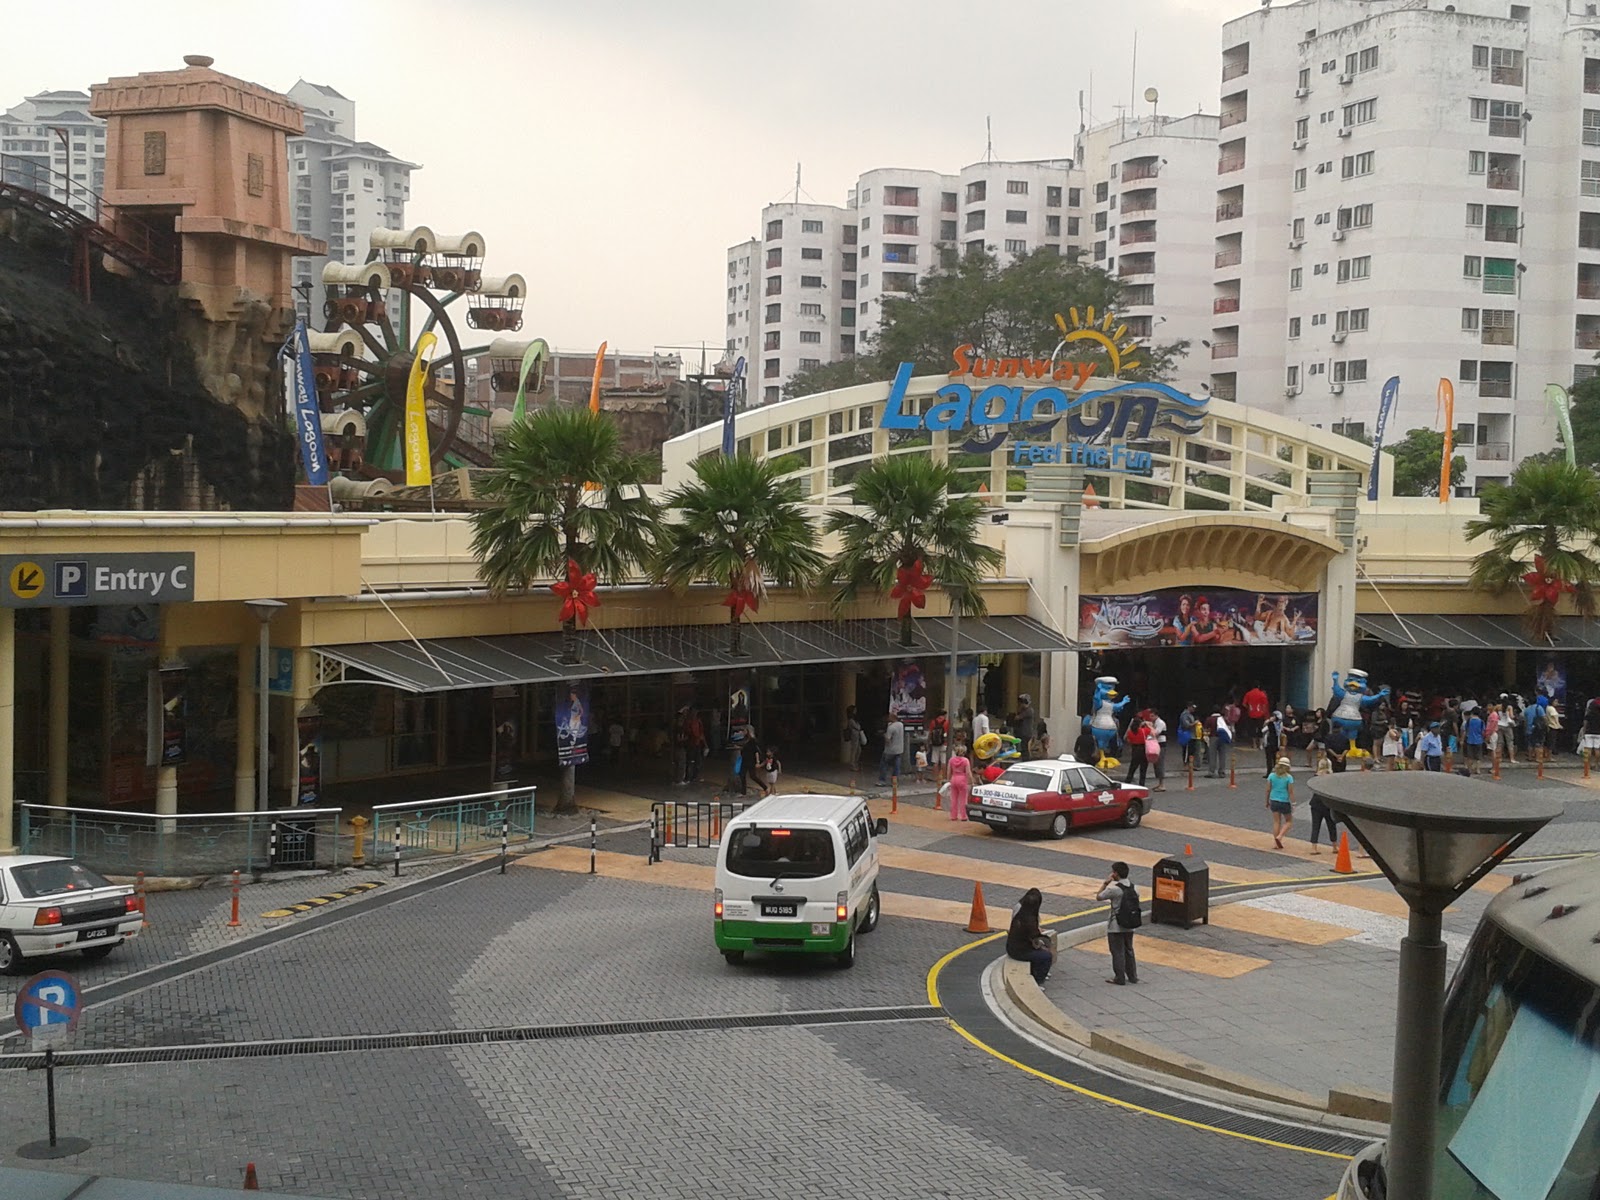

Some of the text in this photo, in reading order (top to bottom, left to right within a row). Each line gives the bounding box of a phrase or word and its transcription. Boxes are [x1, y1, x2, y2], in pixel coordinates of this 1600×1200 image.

[949, 343, 1098, 390] Sunway
[880, 361, 1160, 454] Lagoon
[301, 408, 321, 473] Lagoon
[408, 410, 422, 473] Lagoon
[1014, 440, 1152, 469] Feel The Fun
[61, 565, 187, 596] P Entry C
